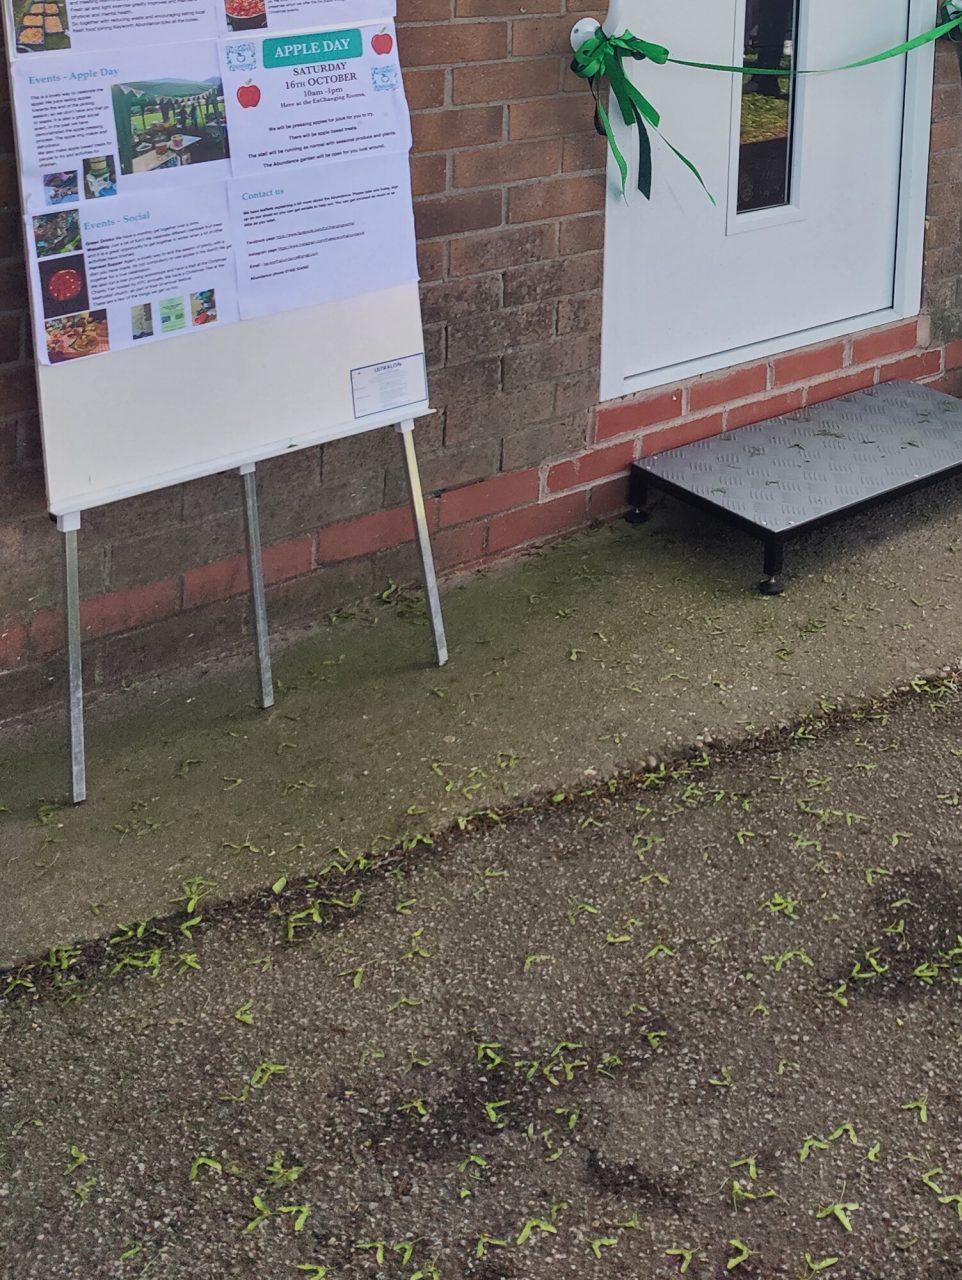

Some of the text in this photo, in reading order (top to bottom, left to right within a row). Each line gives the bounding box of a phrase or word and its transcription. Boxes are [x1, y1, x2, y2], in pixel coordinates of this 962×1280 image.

[274, 41, 321, 58] APPLE
[323, 38, 351, 52] DAY
[28, 74, 61, 85] Events
[69, 70, 98, 84] Apple
[100, 67, 120, 80] Day
[293, 61, 347, 77] SATURDAY
[307, 72, 358, 87] OCTOBER
[303, 89, 324, 98] 10am
[241, 188, 285, 202] Contact us
[83, 218, 116, 231] Events
[122, 211, 150, 225] Social
